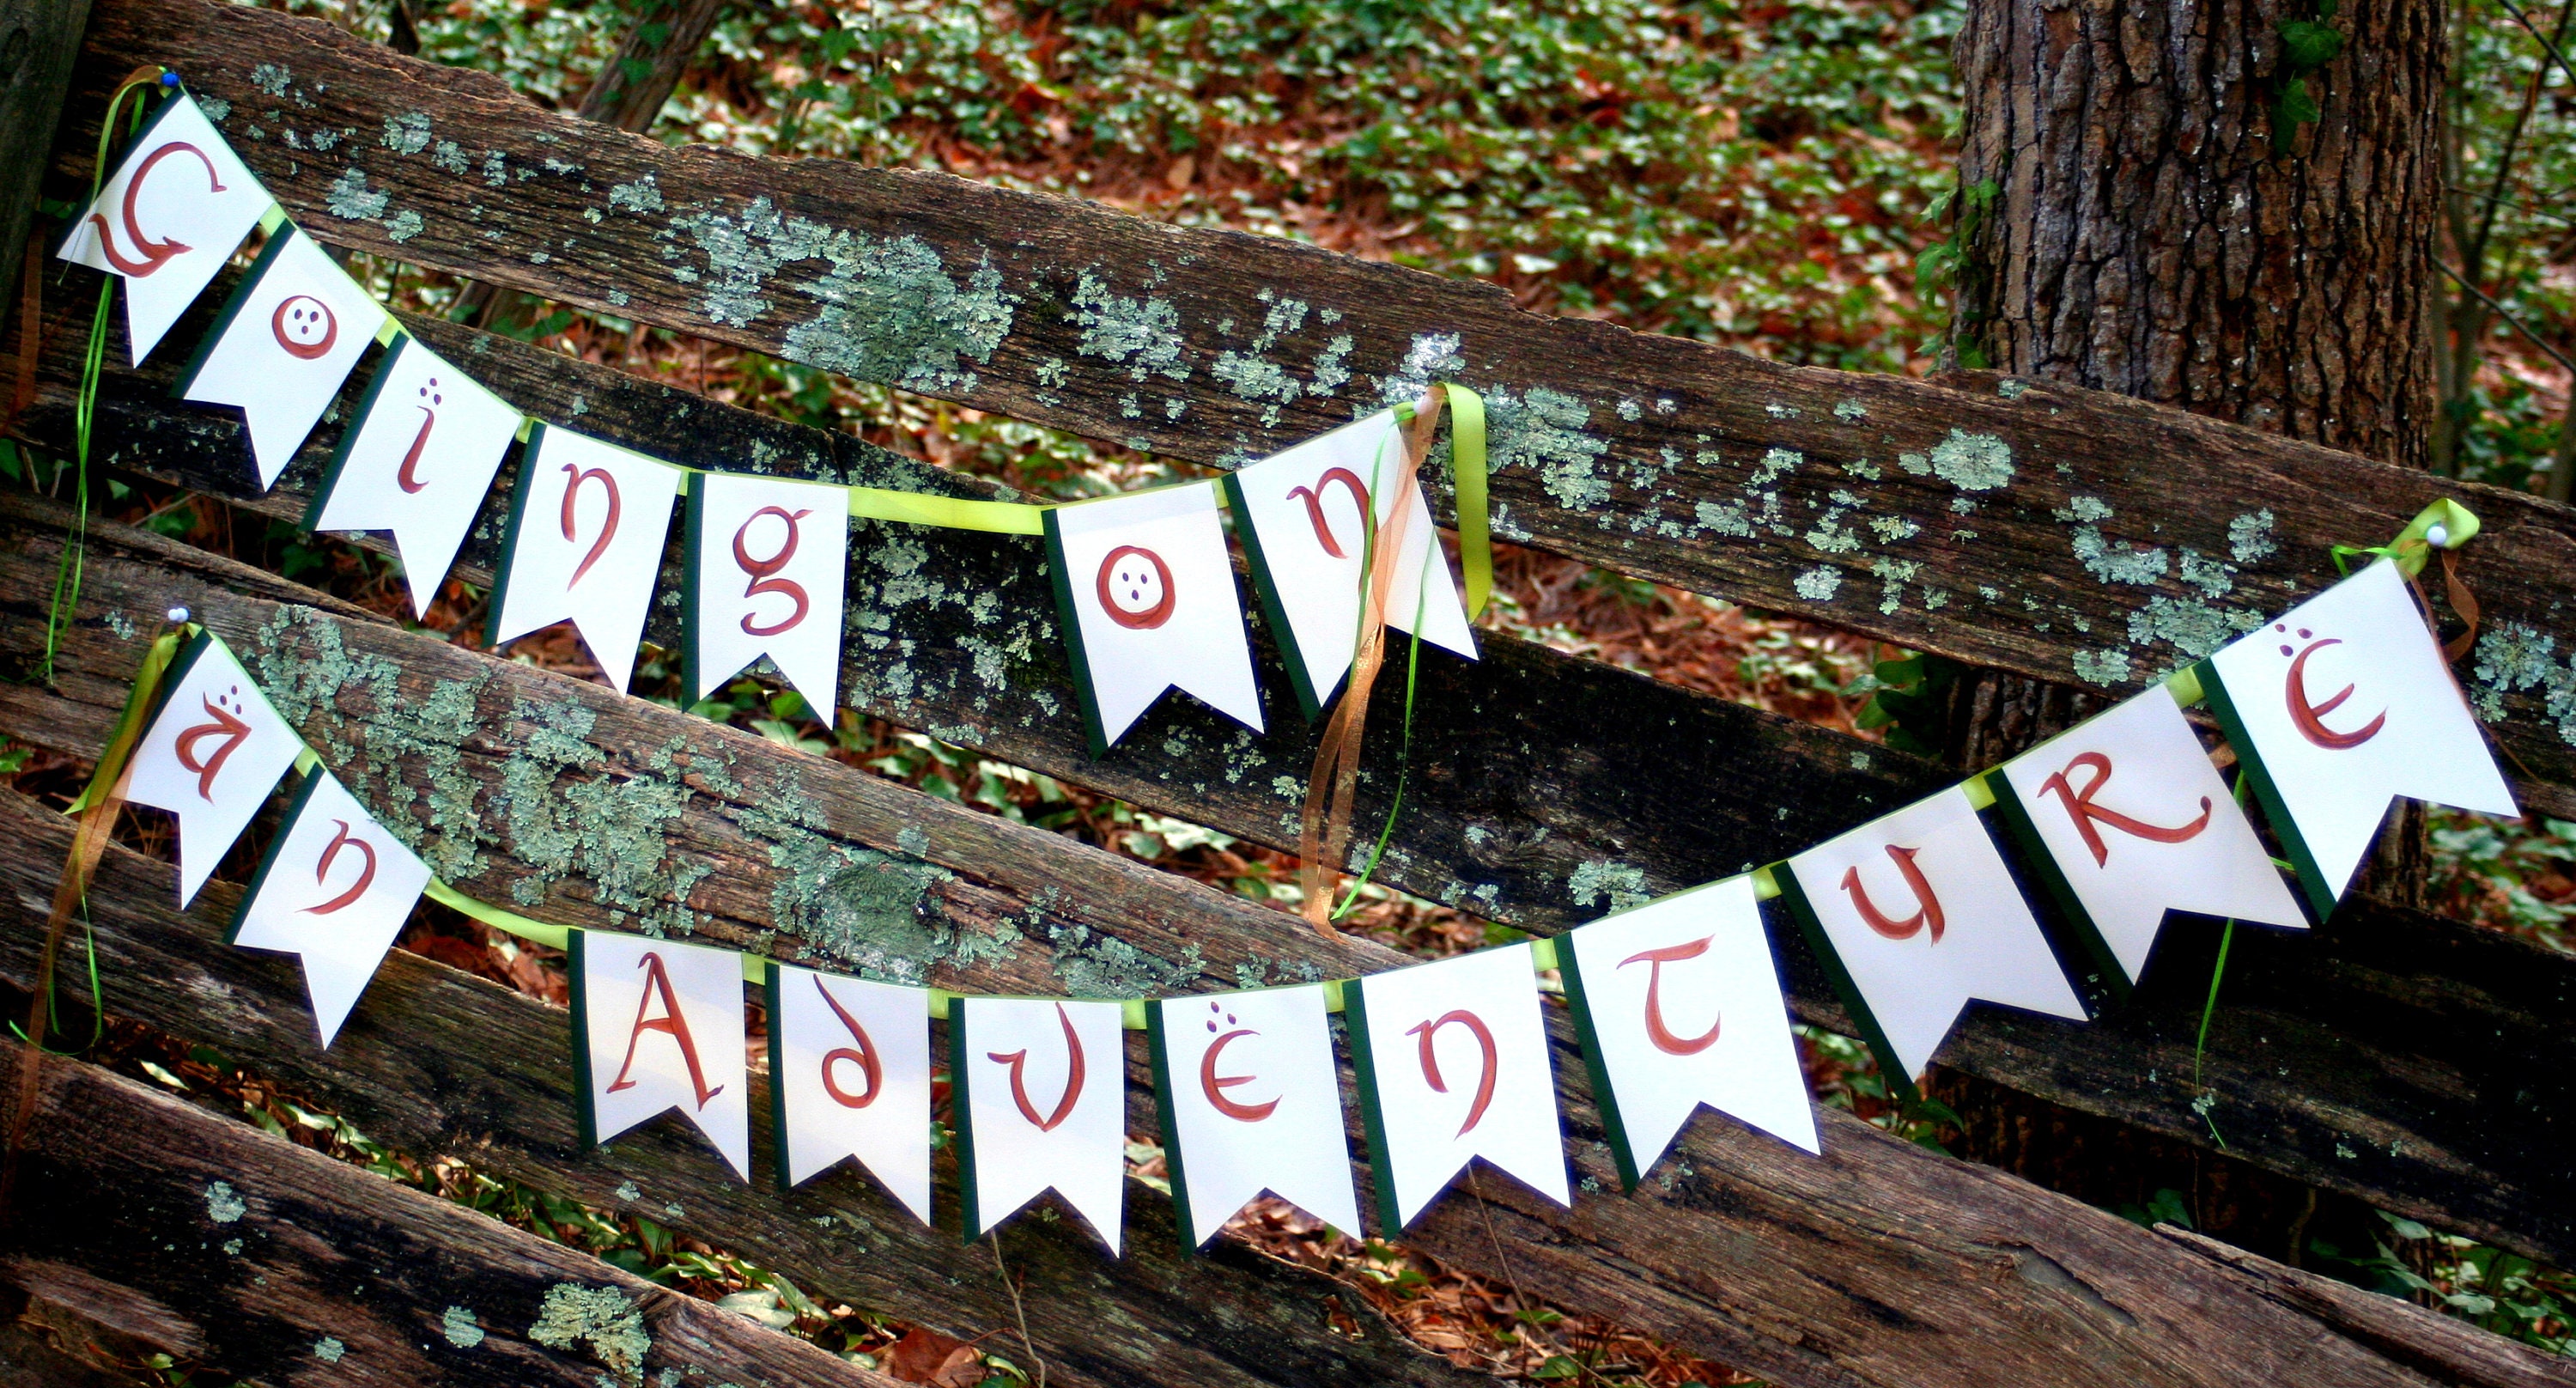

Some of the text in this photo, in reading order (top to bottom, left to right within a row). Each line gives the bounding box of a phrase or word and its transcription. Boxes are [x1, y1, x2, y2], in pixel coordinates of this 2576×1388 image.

[88, 141, 1379, 638] Going on
[174, 685, 378, 916] an
